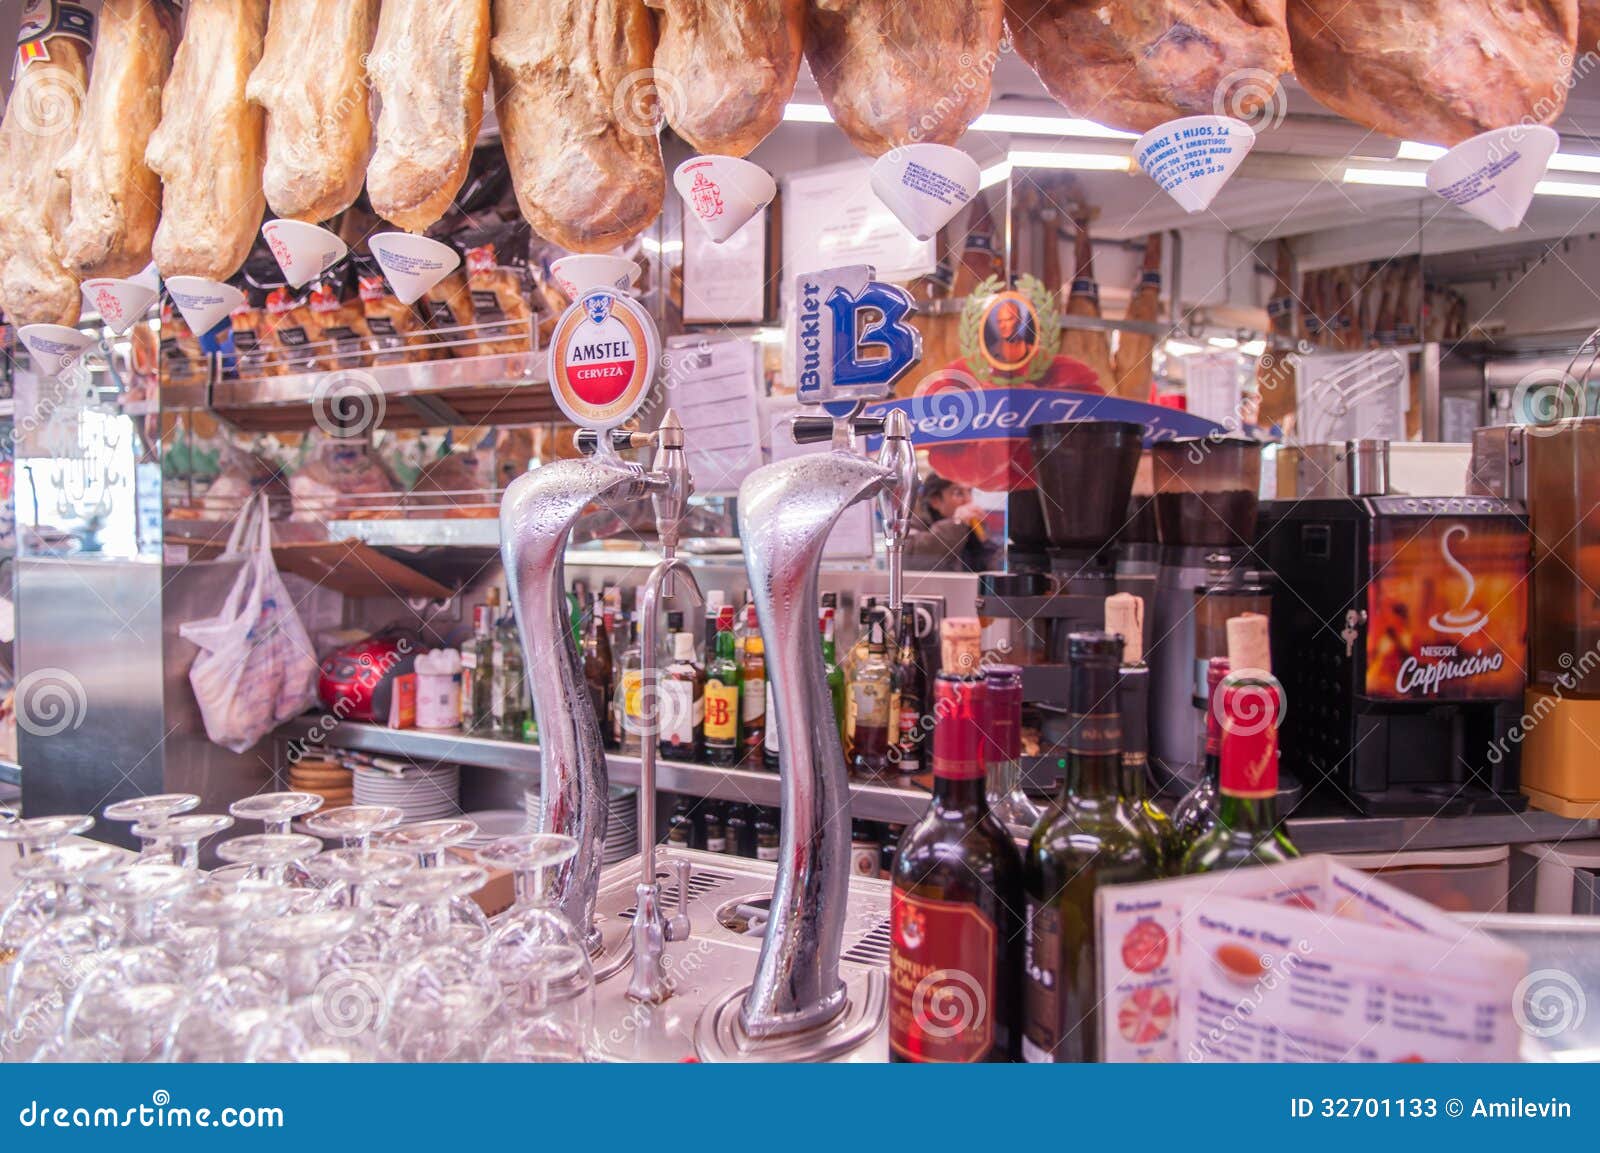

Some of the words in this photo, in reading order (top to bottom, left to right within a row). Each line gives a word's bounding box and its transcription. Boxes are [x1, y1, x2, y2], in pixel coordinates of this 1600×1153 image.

[572, 341, 630, 362] AMSTEL
[800, 282, 820, 392] Buckler
[825, 282, 915, 386] B
[577, 366, 624, 380] CERVEZA
[972, 397, 1045, 431] del
[1396, 648, 1502, 694] Cappuccino
